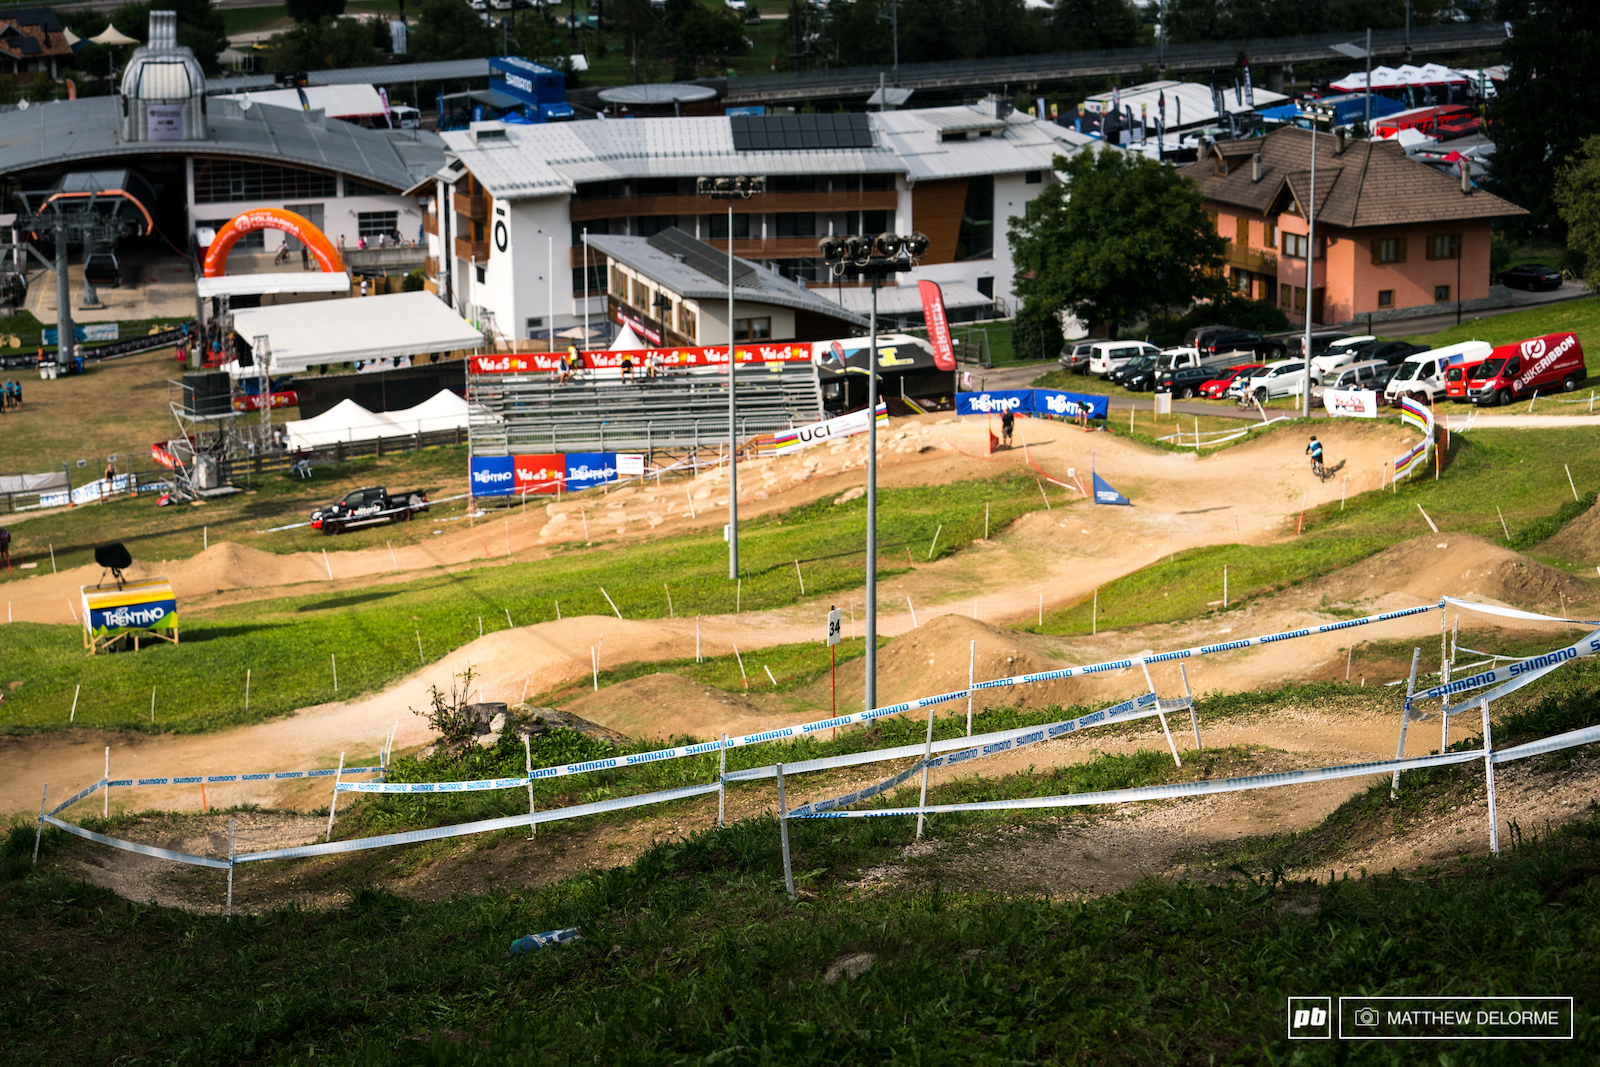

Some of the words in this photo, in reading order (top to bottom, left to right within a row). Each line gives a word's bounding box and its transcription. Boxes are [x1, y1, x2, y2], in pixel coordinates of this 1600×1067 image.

[505, 72, 532, 93] SHIMANO
[1521, 335, 1576, 384] BIKERIBBON
[968, 396, 1020, 412] TRENTINO
[800, 425, 831, 442] UCI
[473, 471, 512, 483] TRENTINO
[354, 504, 381, 516] vittoria
[102, 607, 164, 627] TRENTINO
[829, 619, 840, 637] 34
[1023, 669, 1073, 684] SHIMANO
[1082, 660, 1132, 674] SHIMANO
[1143, 650, 1191, 665] SHIMANO
[1200, 640, 1250, 655] SHIMANO
[1260, 629, 1310, 644] SHIMANO
[1319, 618, 1369, 633] SHIMANO
[1378, 606, 1428, 621] SHIMANO
[1427, 671, 1496, 698] SHIMANO
[1509, 647, 1578, 676] SHIMANO
[567, 759, 617, 773] SHIMANO
[626, 749, 676, 764] SHIMANO
[744, 728, 793, 744] SHIMANO
[802, 716, 851, 733] SHIMANO
[861, 703, 909, 720] SHIMANO
[919, 690, 967, 707] SHIMANO
[947, 749, 977, 764] SHIMANO
[982, 740, 1012, 756] SHIMANO
[1016, 731, 1044, 747] SHIMANO
[1048, 721, 1075, 737] SHIMANO
[1079, 711, 1105, 727] SHIMANO
[1108, 701, 1134, 717] SHIMANO
[138, 778, 168, 786] SHIMANO
[207, 775, 236, 783] SHIMANO
[241, 773, 270, 781] SHIMANO
[275, 771, 303, 779] SHIMANO
[308, 769, 335, 777] SHIMANO
[384, 784, 407, 792] SHIMANO
[411, 784, 434, 792] SHIMANO
[438, 783, 462, 791] SHIMANO
[466, 781, 491, 790] SHIMANO
[495, 778, 520, 787] SHIMANO
